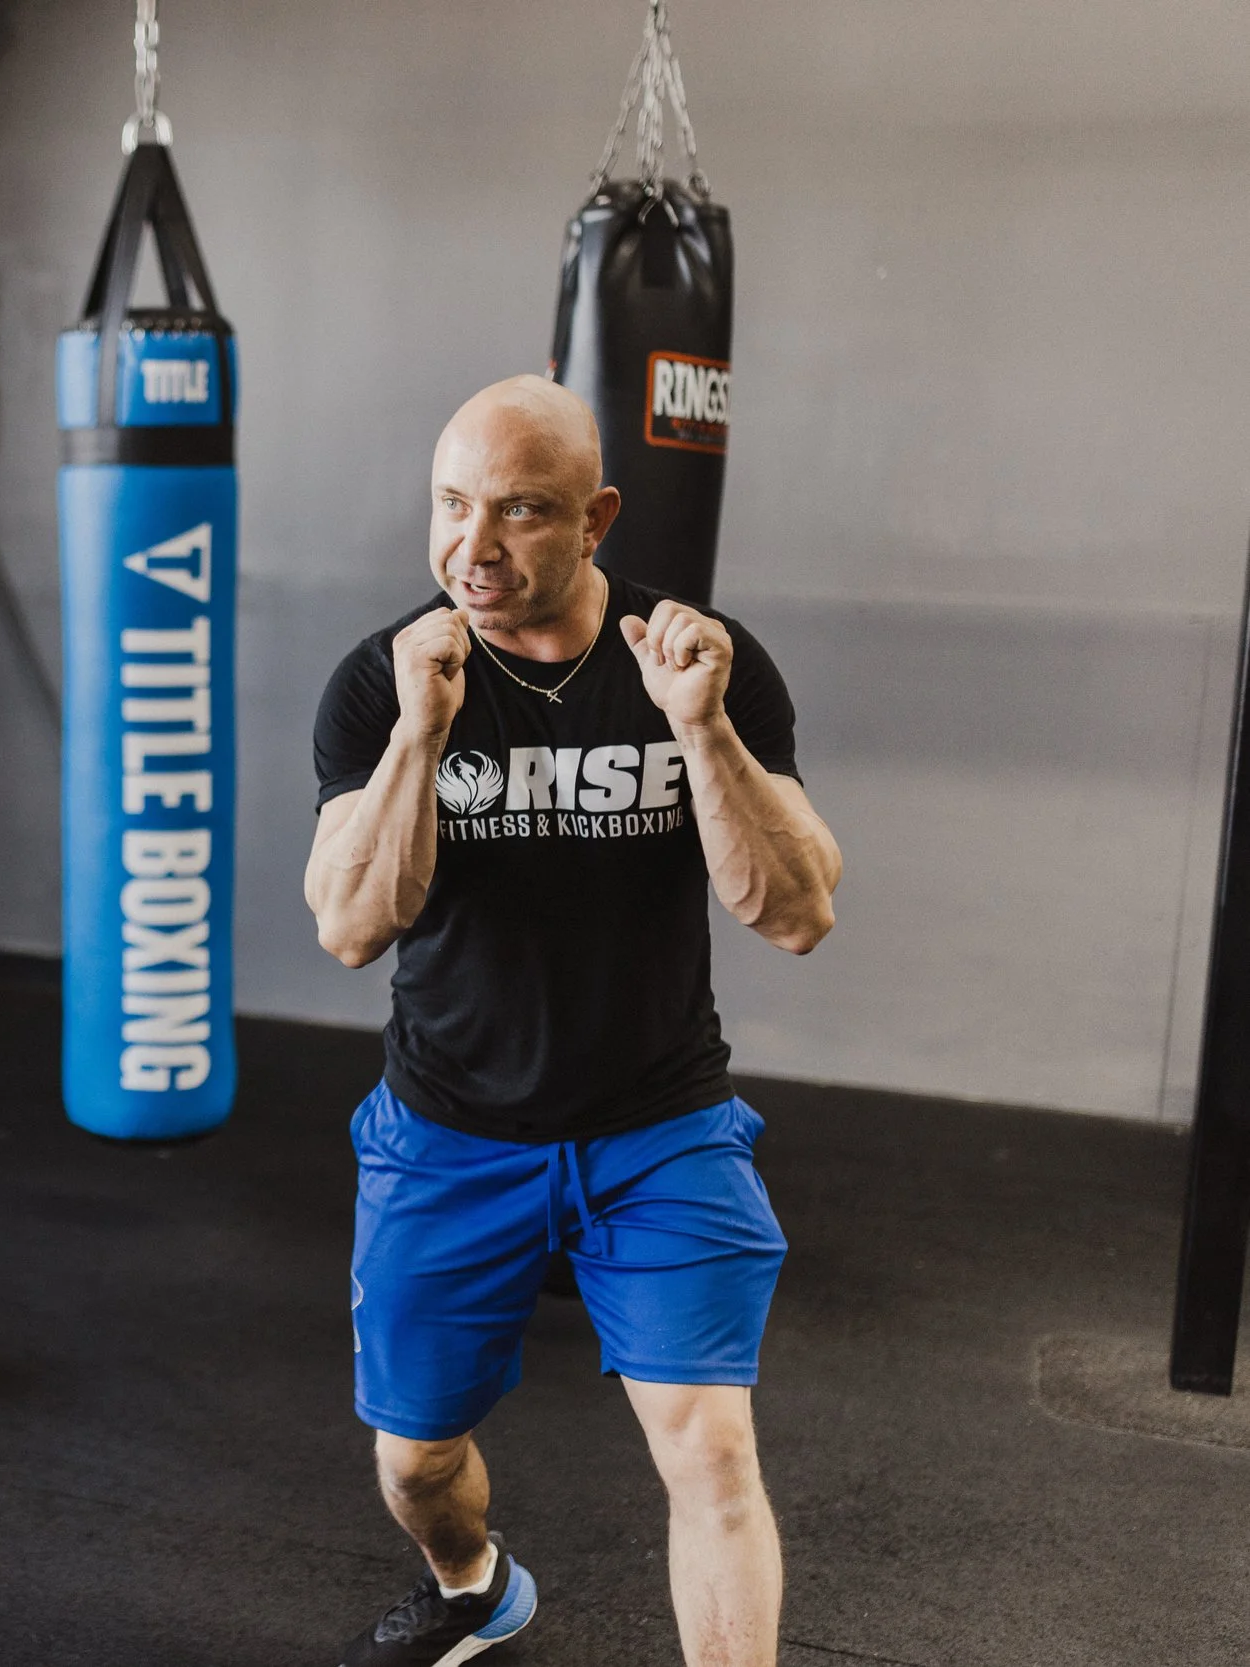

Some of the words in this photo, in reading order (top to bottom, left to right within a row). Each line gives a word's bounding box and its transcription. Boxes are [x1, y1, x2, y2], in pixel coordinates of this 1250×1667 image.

[653, 358, 730, 425] RINGS
[120, 616, 212, 814] TITLE
[505, 741, 683, 812] RISE
[439, 813, 530, 841] FITNESS
[536, 813, 550, 837] &
[557, 806, 684, 839] KICKBOXING
[119, 828, 212, 1092] BOXING
